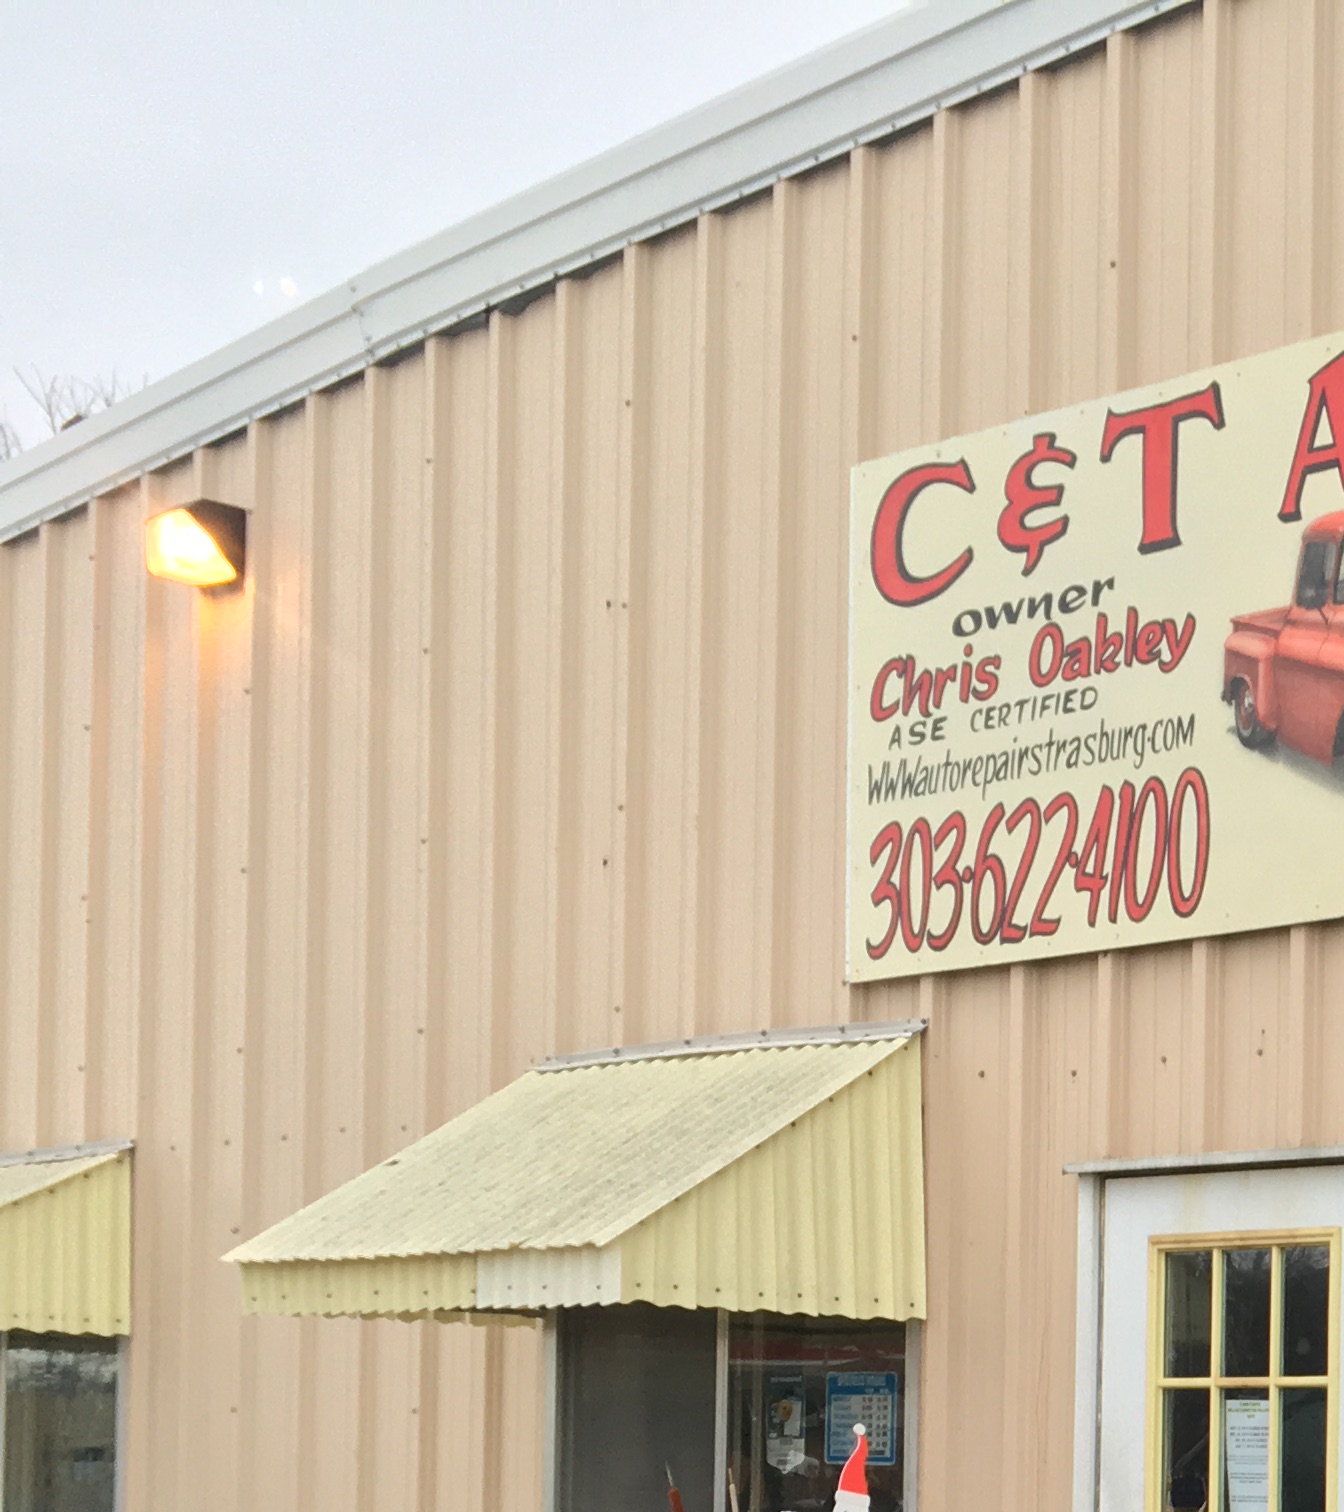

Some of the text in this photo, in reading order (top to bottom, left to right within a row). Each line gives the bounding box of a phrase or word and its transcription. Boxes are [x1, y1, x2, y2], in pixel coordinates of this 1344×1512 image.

[870, 456, 976, 608] C
[997, 432, 1077, 577] &
[1099, 380, 1226, 555] T
[952, 577, 1114, 637] owner
[870, 605, 1196, 722] Chris Oakley
[888, 686, 1098, 750] ASE CERTIFIED
